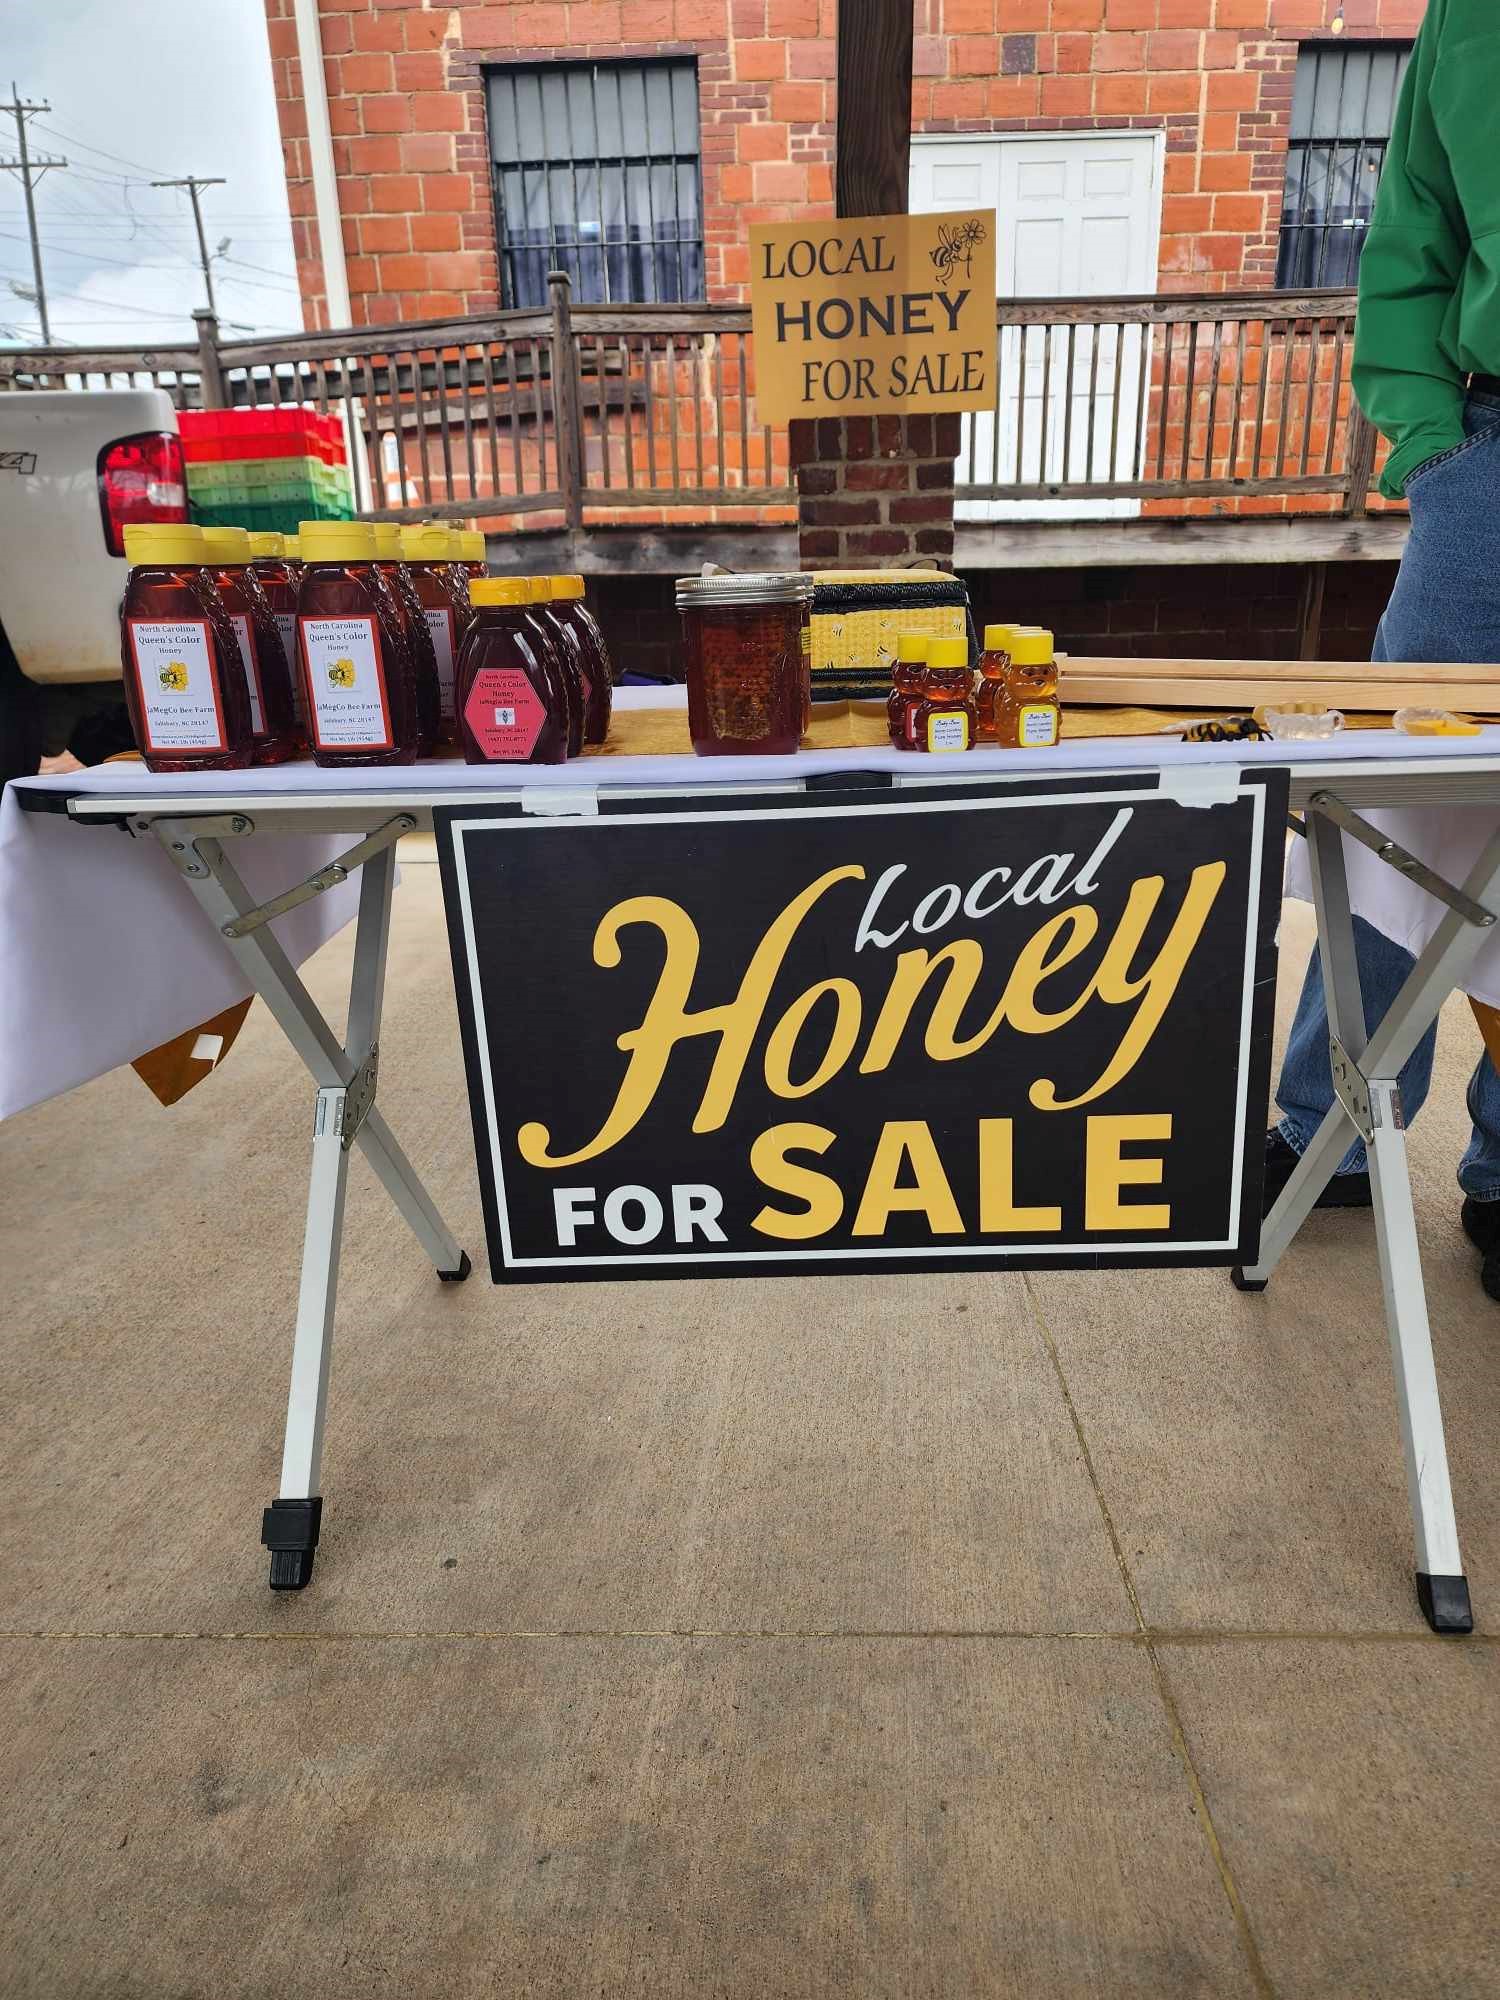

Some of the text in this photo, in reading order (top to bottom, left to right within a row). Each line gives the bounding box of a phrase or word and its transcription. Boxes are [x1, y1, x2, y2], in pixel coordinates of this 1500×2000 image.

[762, 236, 895, 278] LOCAL
[775, 290, 971, 342] HONEY
[801, 350, 985, 402] FOR SALE
[138, 635, 201, 646] Queen's Color
[162, 624, 197, 632] Carolina
[309, 631, 368, 642] Queen's Color
[159, 647, 182, 655] Honey
[327, 644, 349, 652] Honey
[492, 690, 514, 698] Honey
[855, 808, 1133, 952] Local
[518, 861, 1226, 1168] Honey
[553, 1114, 1172, 1246] FOR SALE
